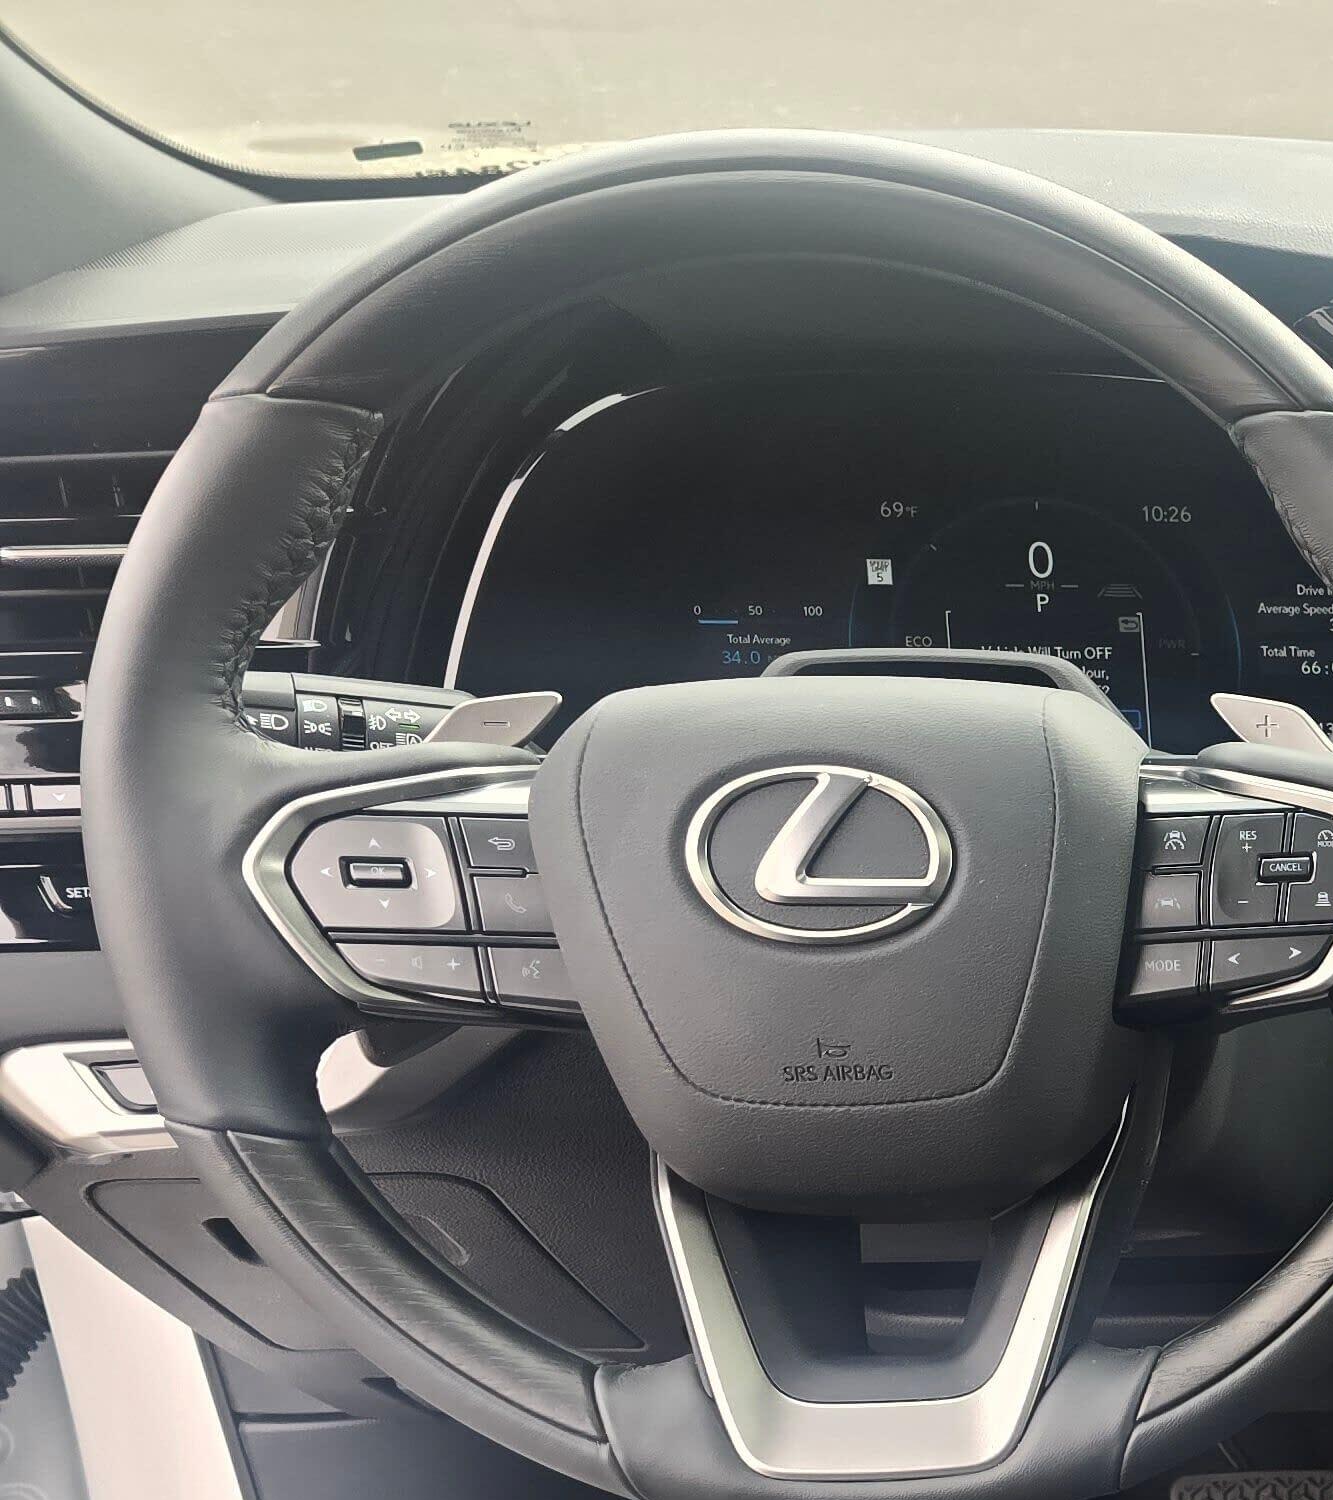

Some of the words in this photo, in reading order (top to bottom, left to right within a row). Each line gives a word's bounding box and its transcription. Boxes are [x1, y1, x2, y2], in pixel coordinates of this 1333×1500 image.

[1142, 506, 1192, 523] 10:26
[1028, 541, 1054, 579] 0
[1296, 584, 1325, 596] Drive
[1036, 594, 1050, 613] P
[1258, 603, 1300, 616] Average
[693, 605, 702, 616] 0
[748, 605, 763, 616] 50
[803, 605, 823, 617] 100
[727, 634, 751, 645] Total
[752, 634, 792, 647] Average
[905, 636, 933, 647] ECO
[721, 651, 761, 665] 34.0
[1054, 647, 1081, 660] Turn
[1084, 647, 1112, 660] OFF
[1261, 647, 1286, 658] Total
[1289, 647, 1316, 659] Time
[1239, 830, 1257, 841] RES
[1269, 862, 1303, 874] CANCEL
[1144, 959, 1182, 973] MODE
[782, 1065, 818, 1082] SRS
[823, 1064, 893, 1082] AIRBAG
